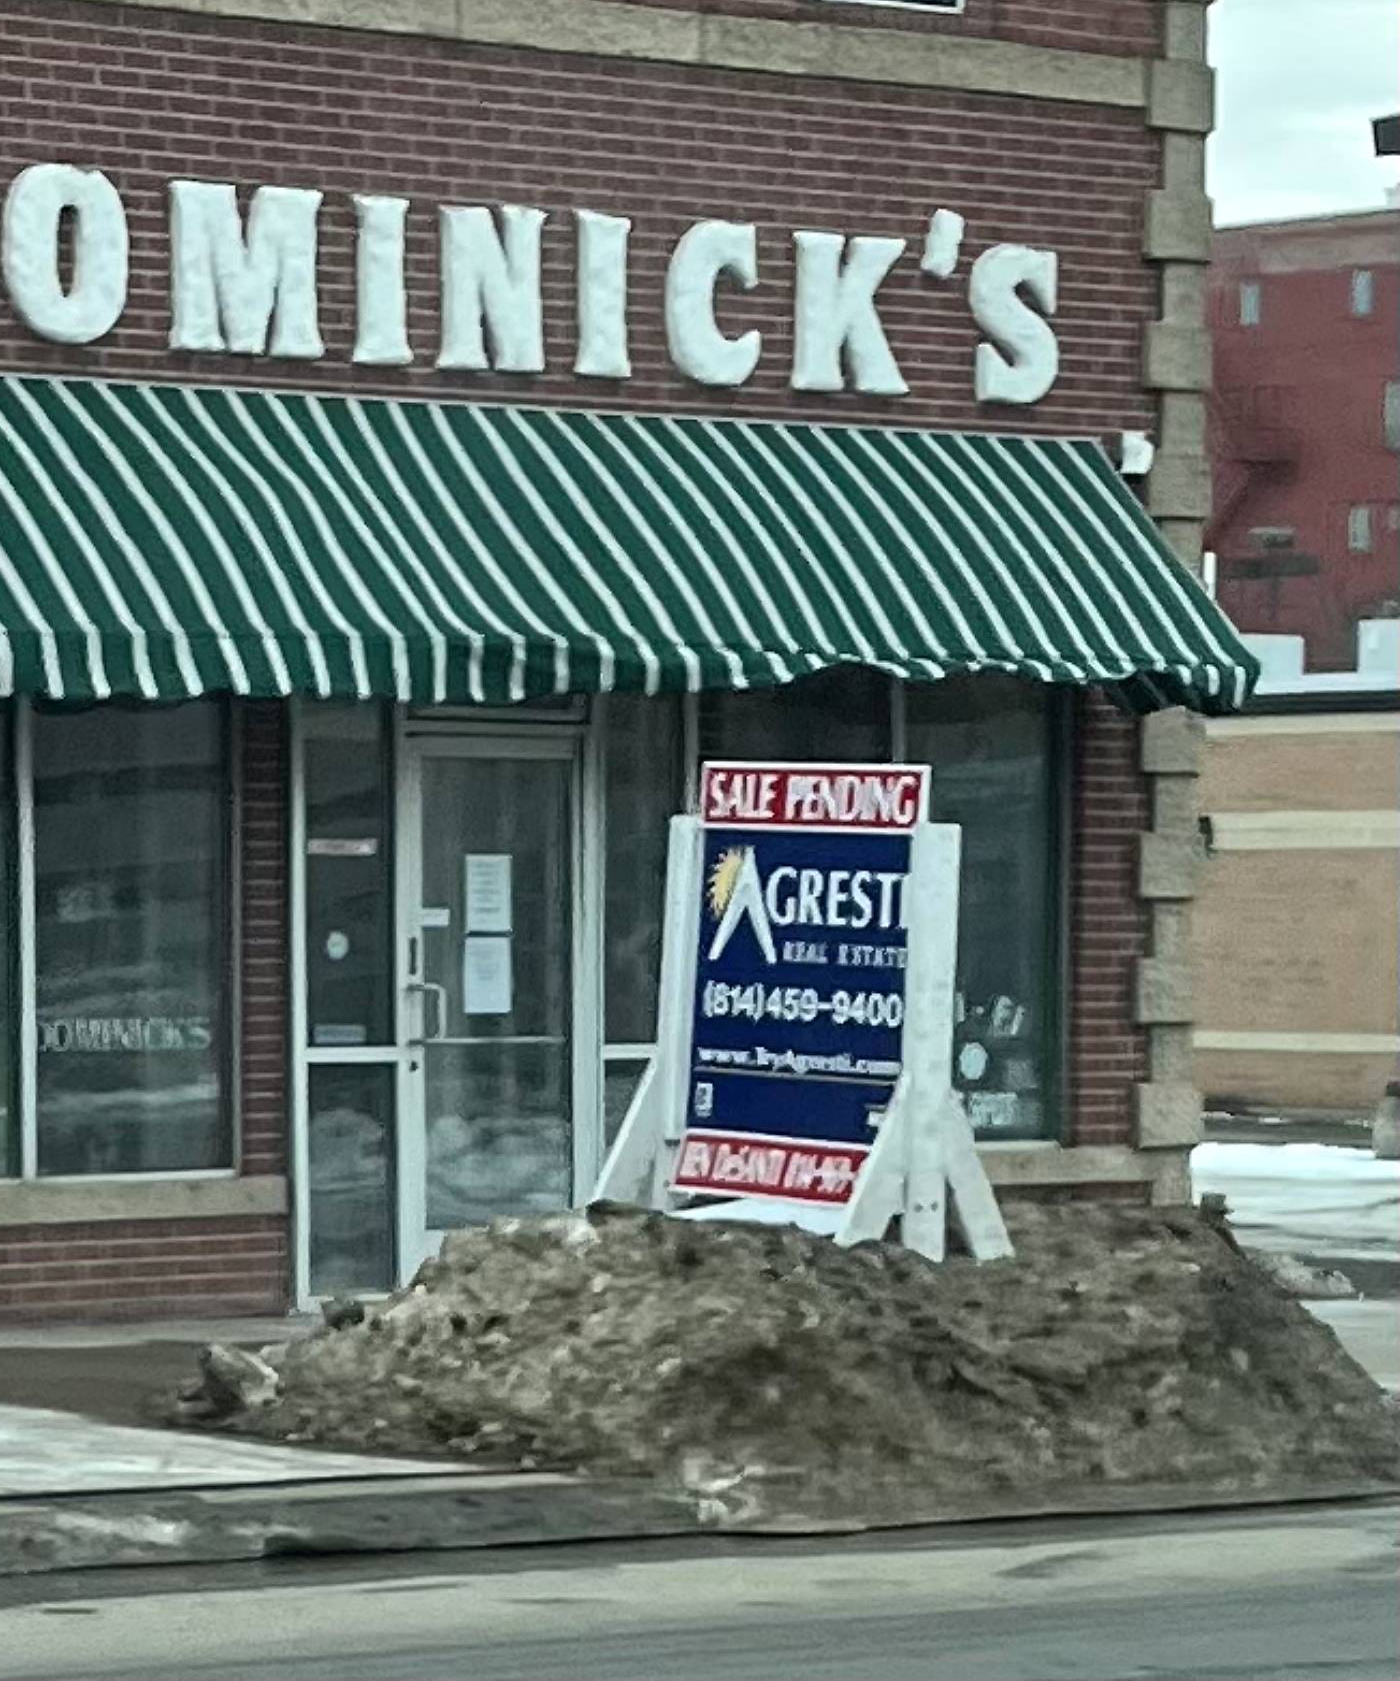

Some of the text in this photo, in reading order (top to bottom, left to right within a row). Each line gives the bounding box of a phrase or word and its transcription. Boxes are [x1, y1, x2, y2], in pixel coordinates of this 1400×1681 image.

[709, 771, 918, 824] SALE PENDING
[783, 941, 829, 964] REAL
